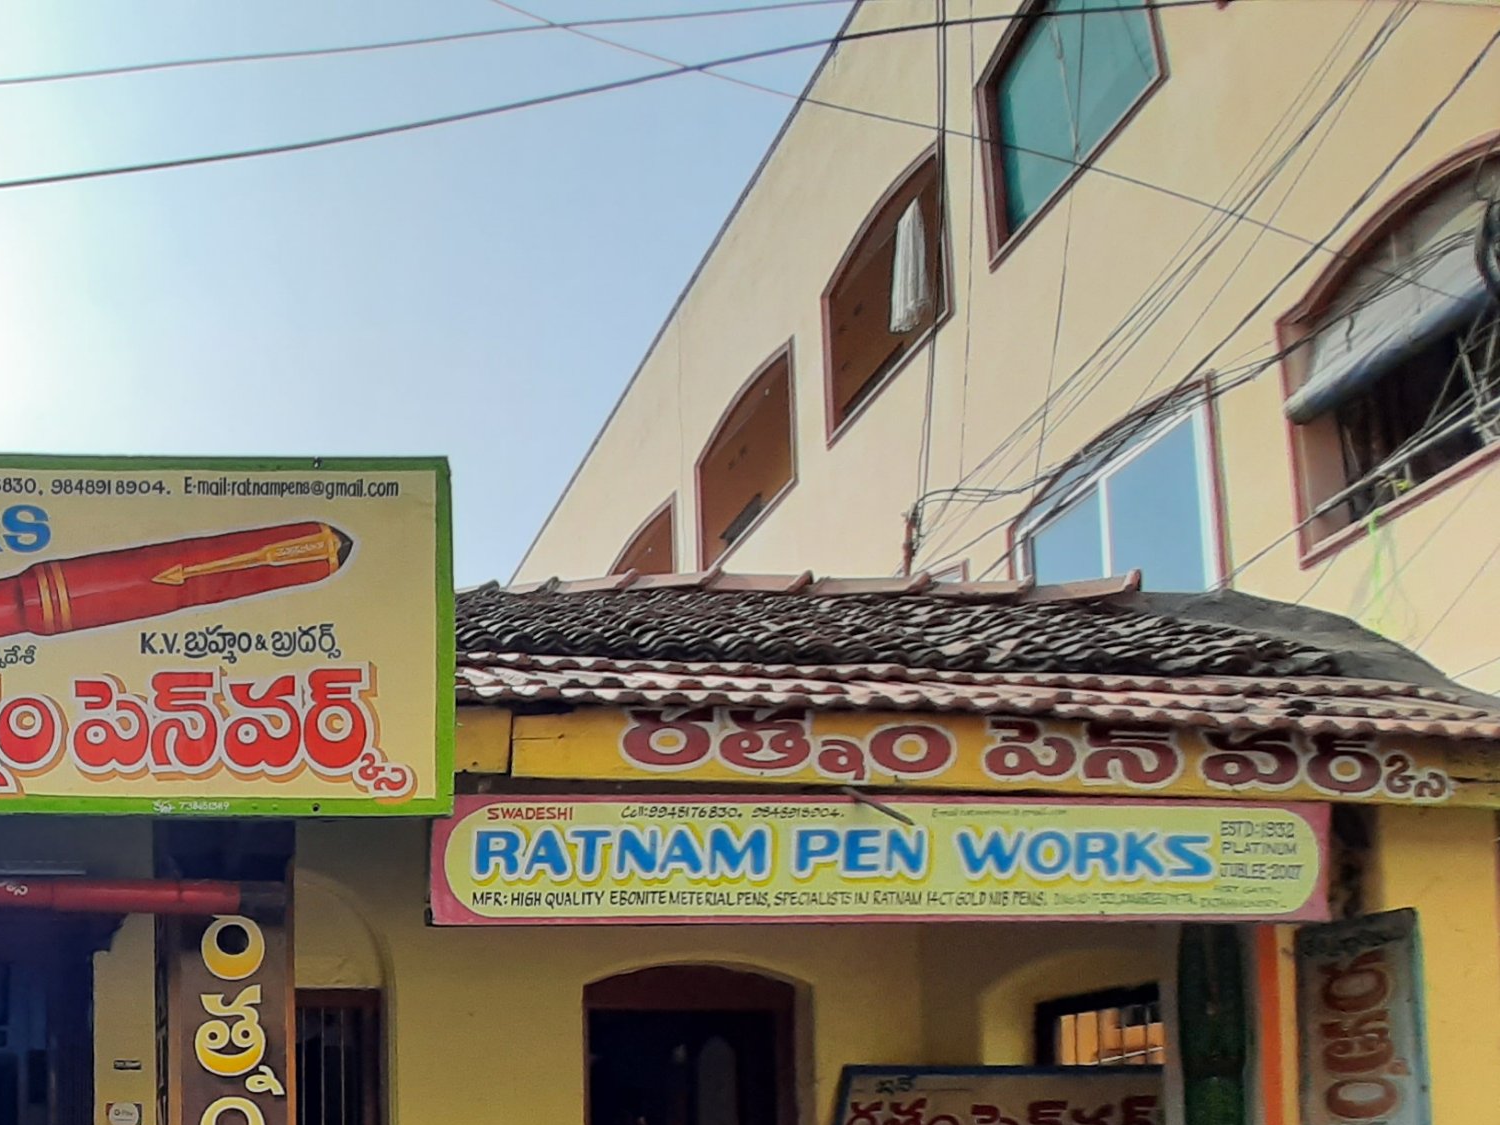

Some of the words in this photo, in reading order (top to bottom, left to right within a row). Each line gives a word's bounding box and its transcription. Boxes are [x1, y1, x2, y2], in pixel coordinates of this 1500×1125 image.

[487, 806, 573, 820] SWADESHI
[473, 827, 768, 876] RATNAM
[795, 828, 925, 875] PEN
[956, 831, 1213, 877] WORKS
[472, 892, 507, 906] MFR:
[511, 892, 542, 907] HIGH
[545, 891, 605, 909] QUALITY
[610, 891, 667, 906] EBONITE
[873, 891, 922, 906] RATNAM
